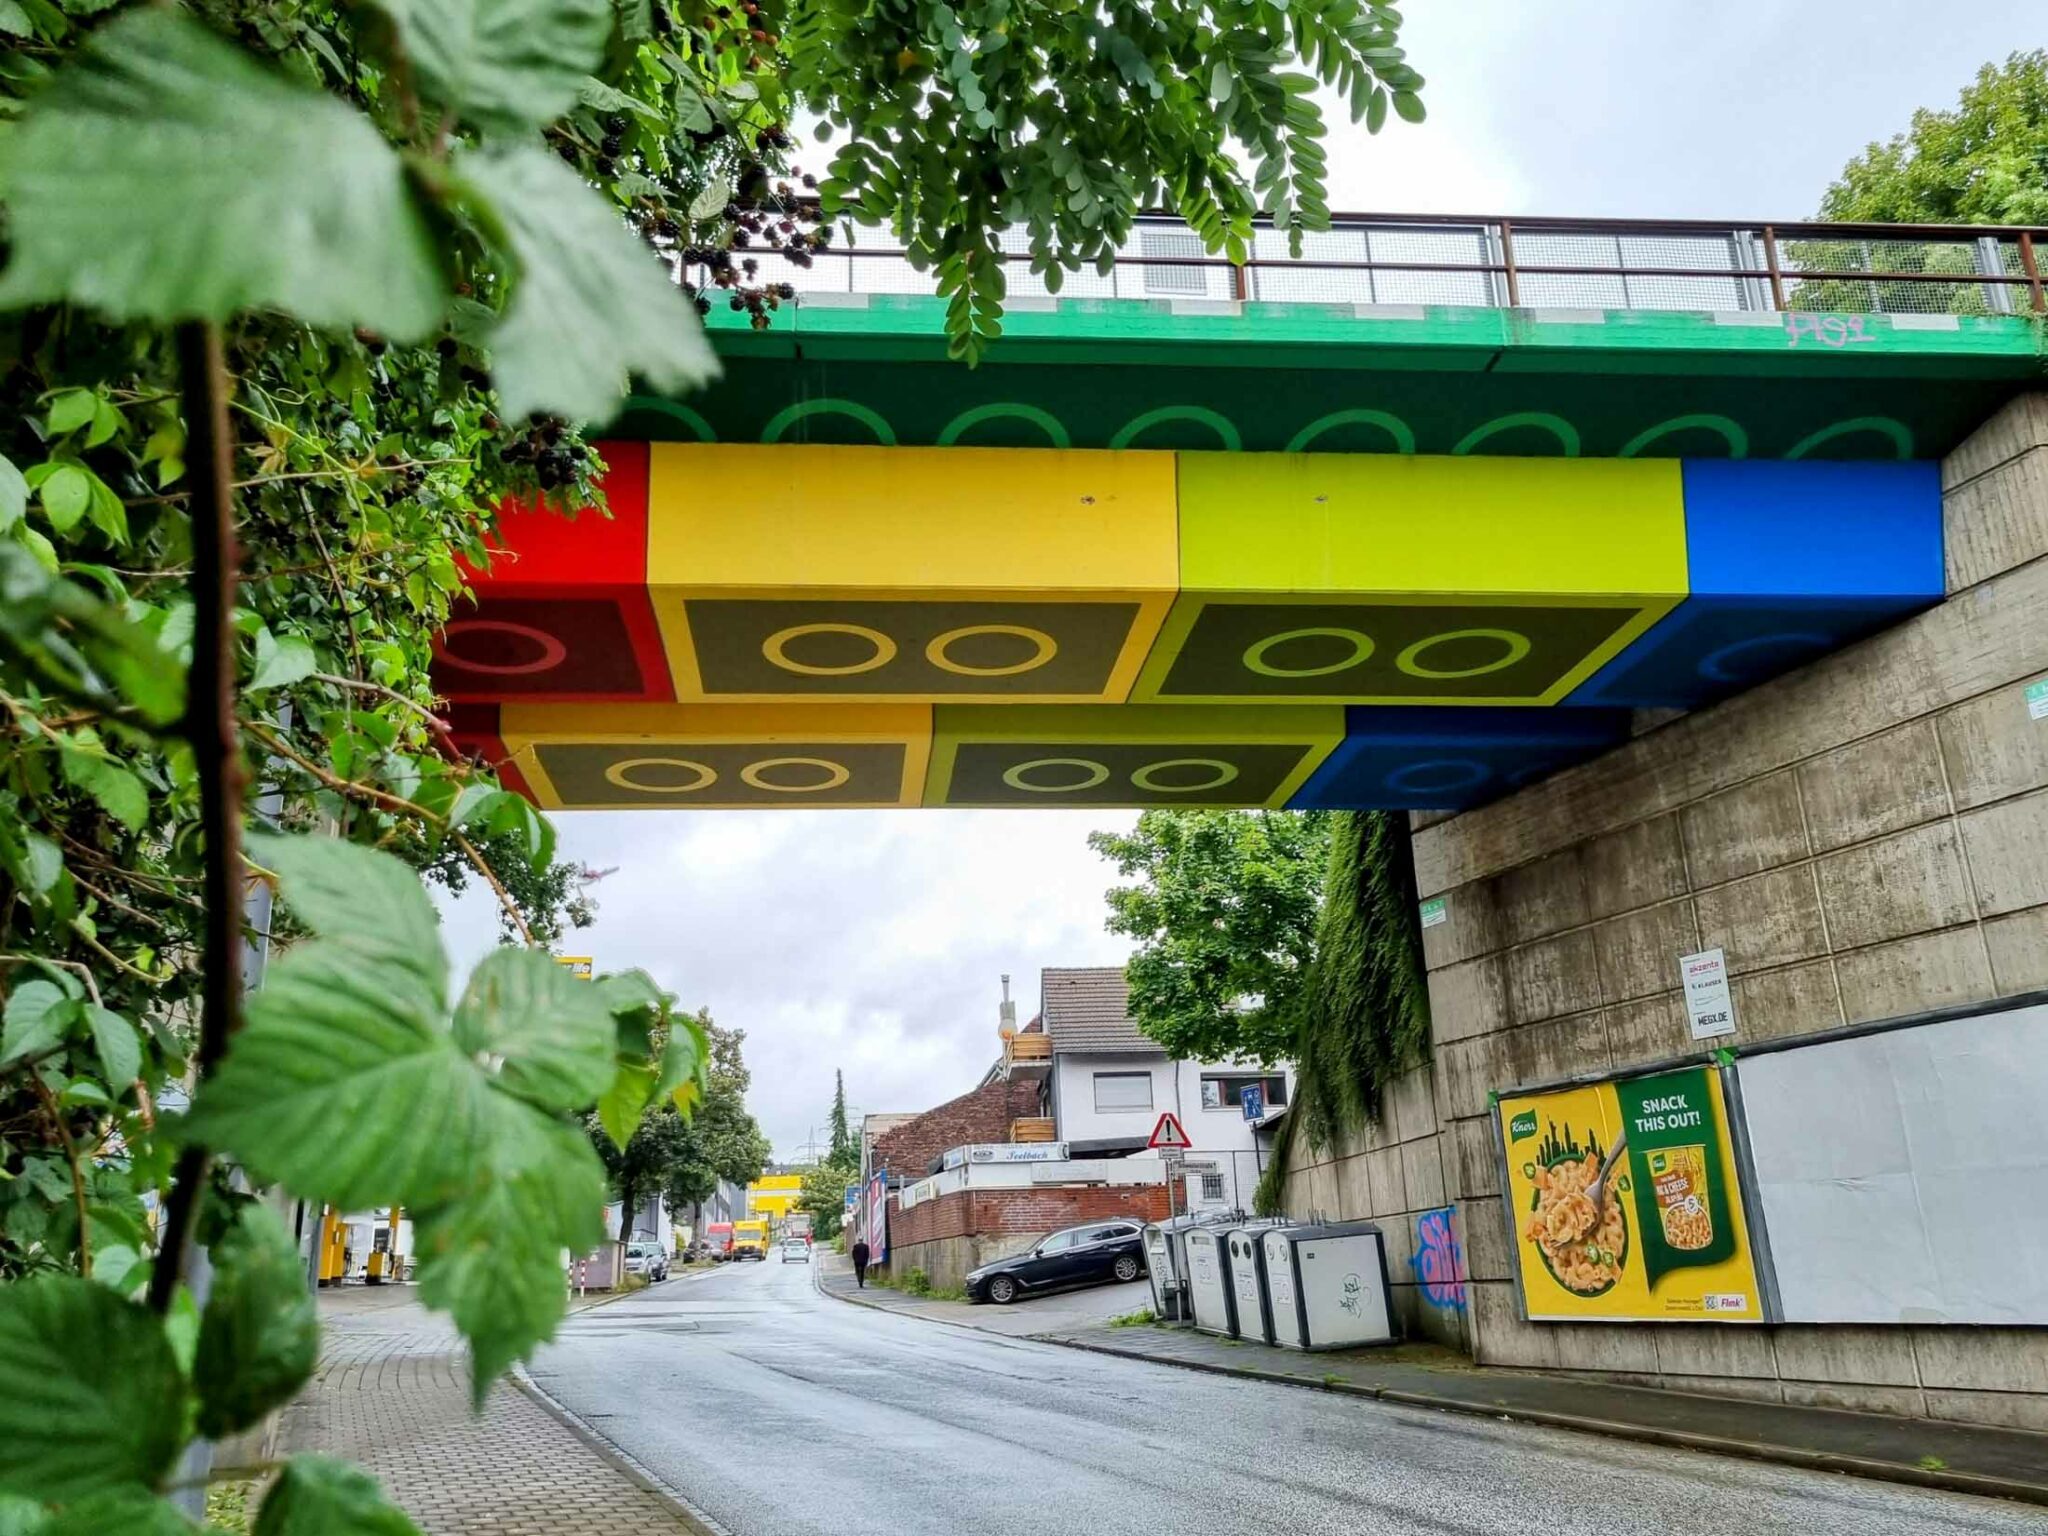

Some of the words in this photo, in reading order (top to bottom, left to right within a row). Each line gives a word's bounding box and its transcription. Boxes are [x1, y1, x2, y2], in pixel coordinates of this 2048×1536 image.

[1642, 1094, 1688, 1114] SNACK
[1635, 1116, 1666, 1133] THIS
[1667, 1111, 1701, 1129] OUT!
